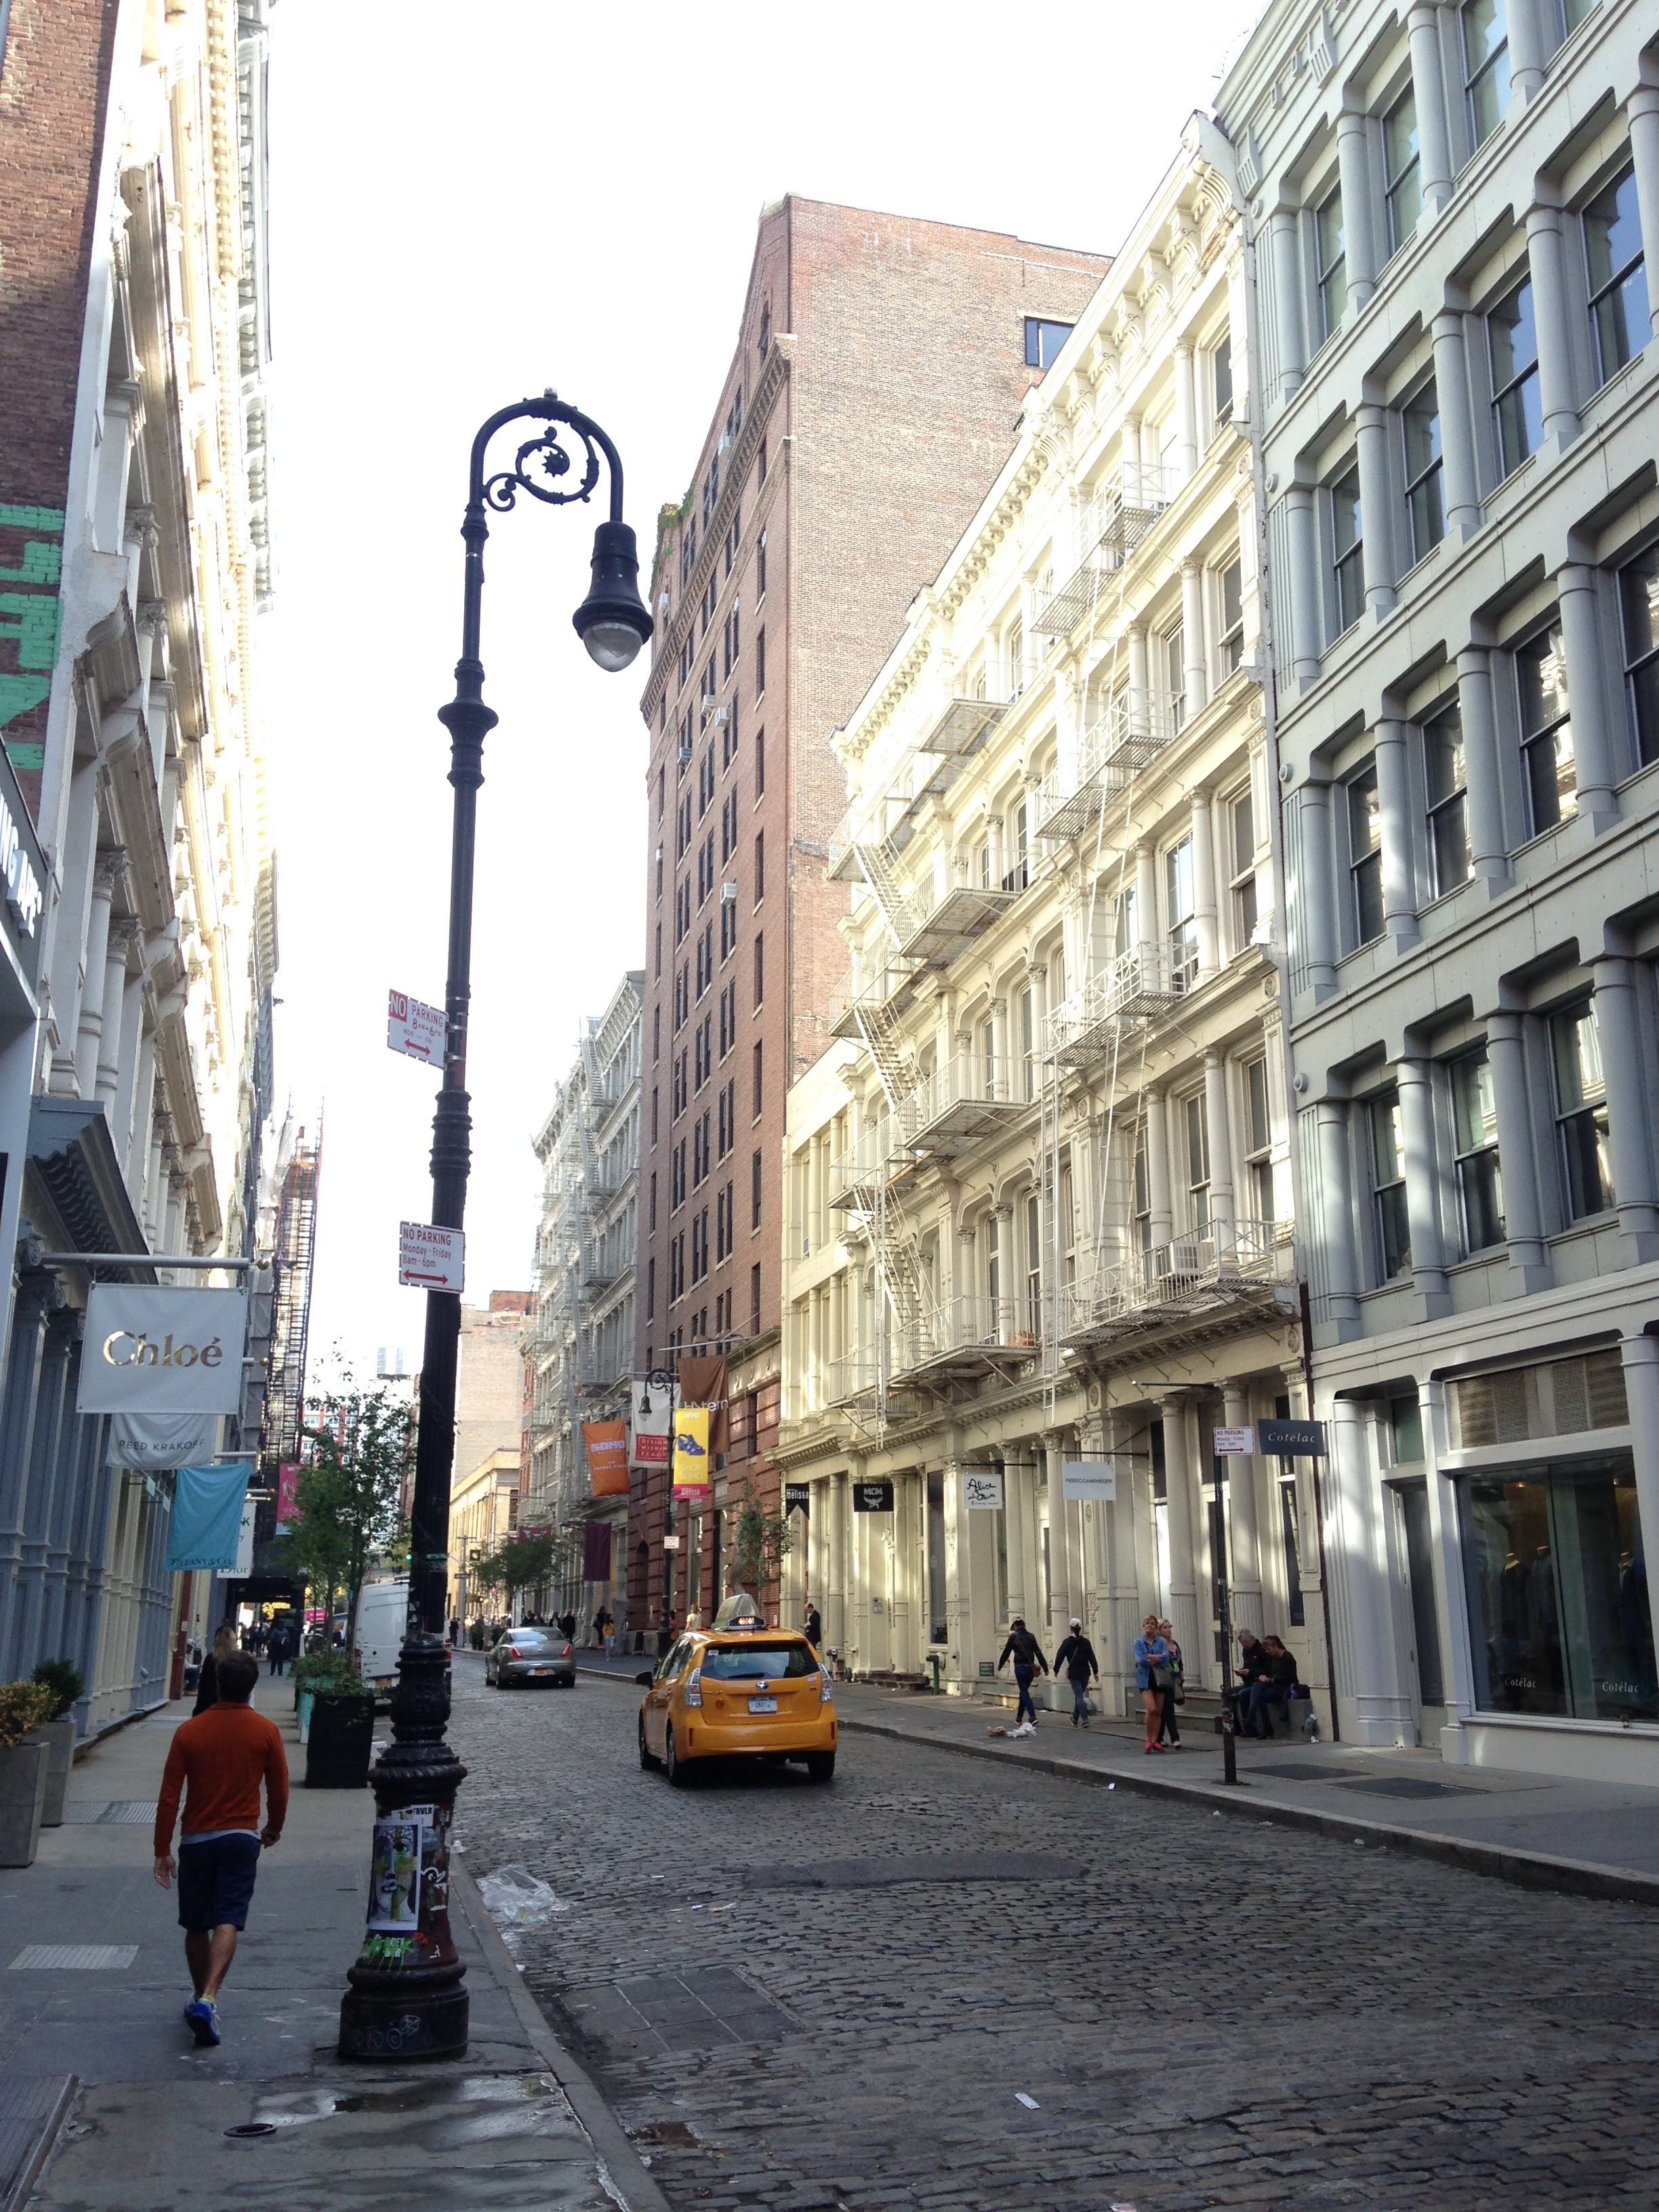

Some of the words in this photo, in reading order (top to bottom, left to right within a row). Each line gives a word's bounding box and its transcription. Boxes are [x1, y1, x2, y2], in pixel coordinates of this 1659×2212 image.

[390, 994, 407, 1017] NO
[412, 1005, 443, 1027] PARKING
[403, 1228, 414, 1240] NO
[417, 1230, 451, 1246] PARKING
[403, 1243, 427, 1256] Monday
[432, 1248, 451, 1260] Friday
[403, 1254, 417, 1265] 8am
[422, 1258, 436, 1268] 6pm
[102, 1330, 222, 1368] Chloé
[1268, 1432, 1315, 1443] Cotélac
[119, 1440, 148, 1450] REED
[152, 1439, 205, 1451] KRAKOFF
[1504, 1677, 1536, 1689] Cotélac
[1602, 1681, 1639, 1694] Cotélac
